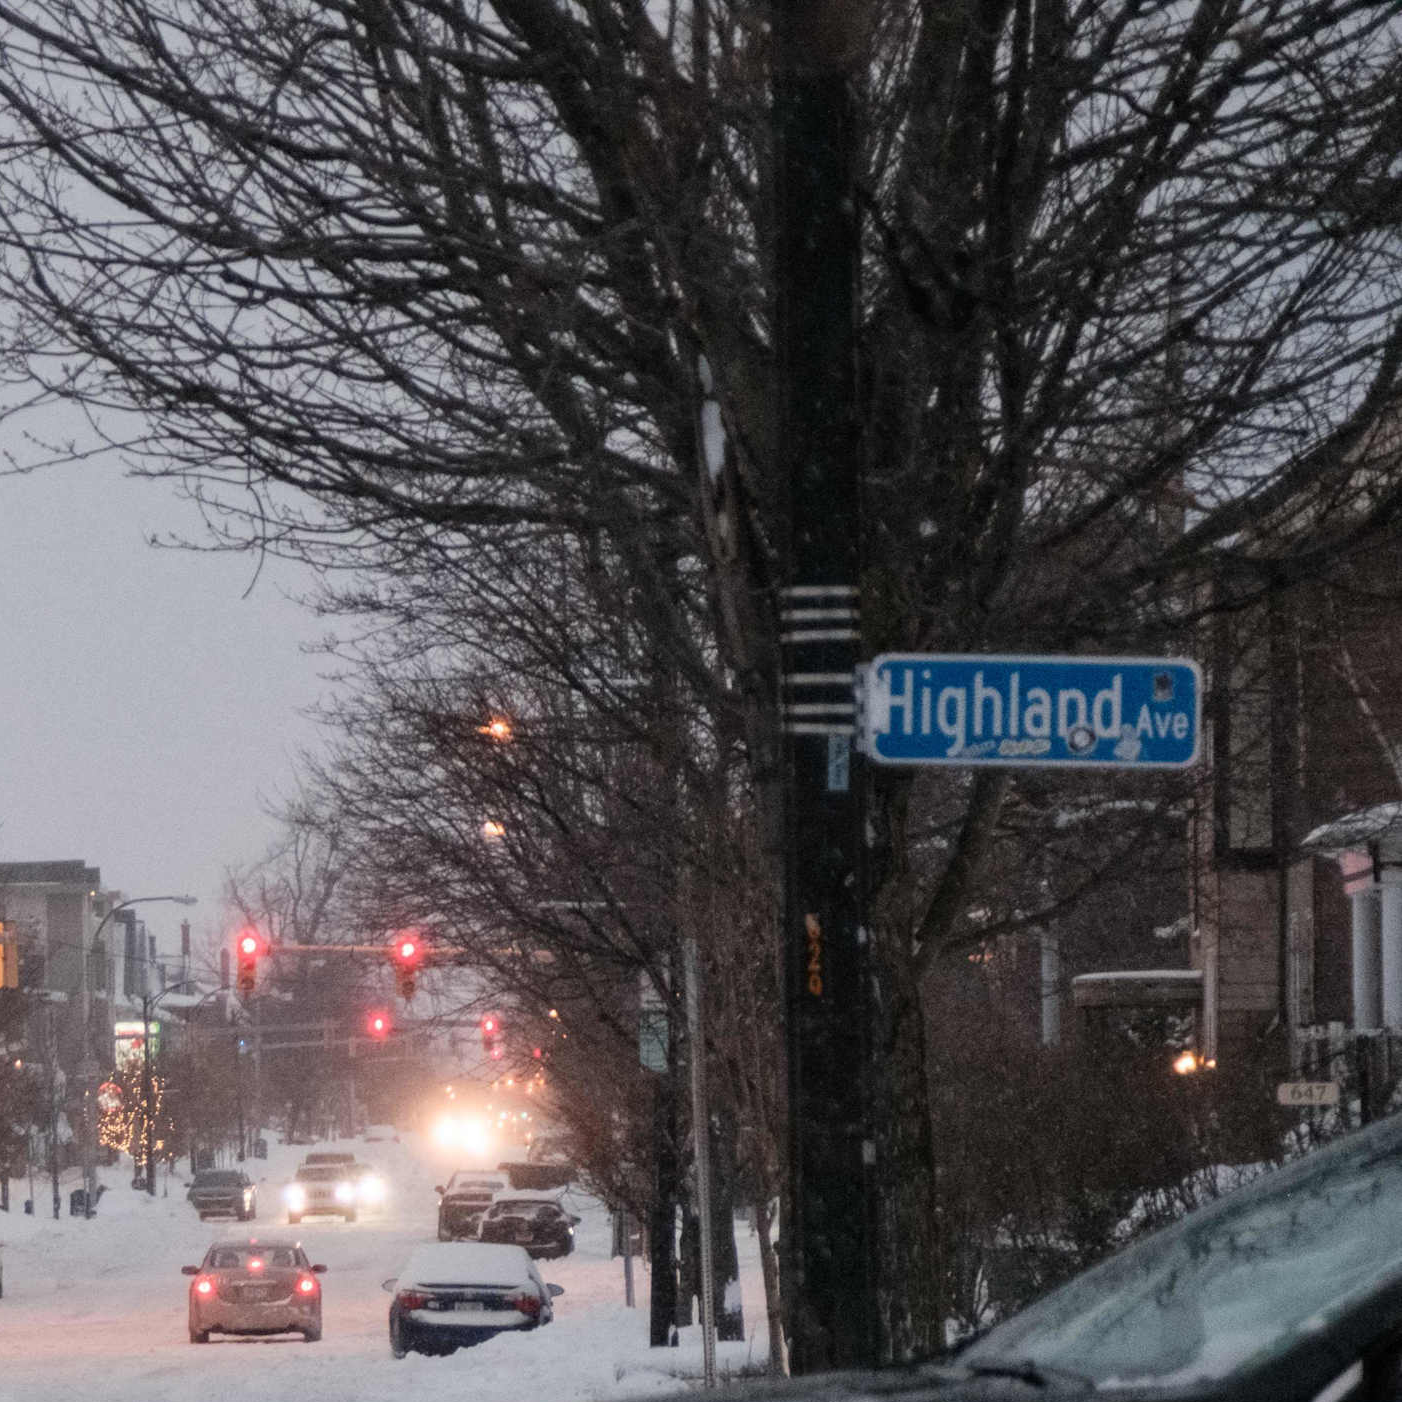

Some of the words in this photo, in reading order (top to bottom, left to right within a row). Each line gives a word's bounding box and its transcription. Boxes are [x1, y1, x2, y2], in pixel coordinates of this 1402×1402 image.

[882, 668, 1123, 757] Highland
[1137, 704, 1189, 739] Ave
[1290, 1085, 1326, 1101] 647
